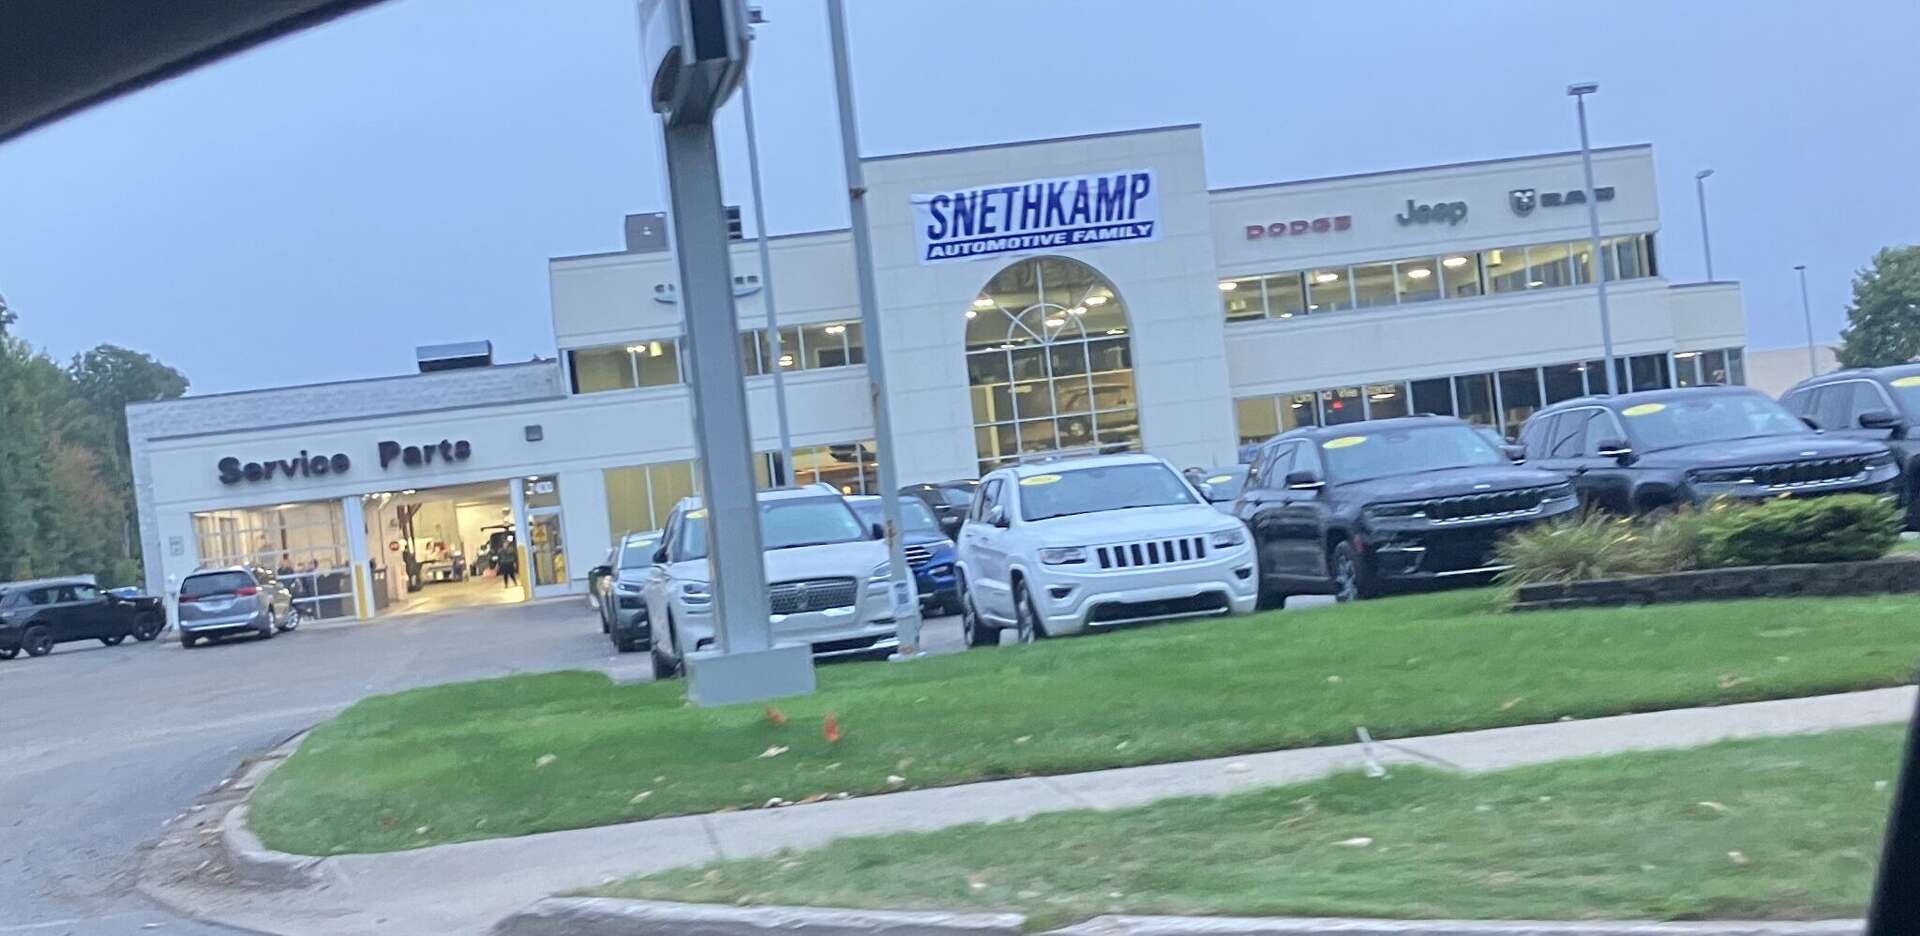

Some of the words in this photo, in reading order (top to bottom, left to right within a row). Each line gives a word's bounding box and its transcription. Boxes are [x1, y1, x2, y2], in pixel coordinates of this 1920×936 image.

[927, 172, 1150, 240] SNETHKAMP
[1396, 199, 1468, 227] Jeep
[929, 231, 1067, 258] AUTOMOTIVE
[1072, 224, 1152, 242] FAMILY
[1246, 215, 1352, 241] DODGE
[218, 450, 350, 485] Service
[378, 439, 471, 468] Parts
